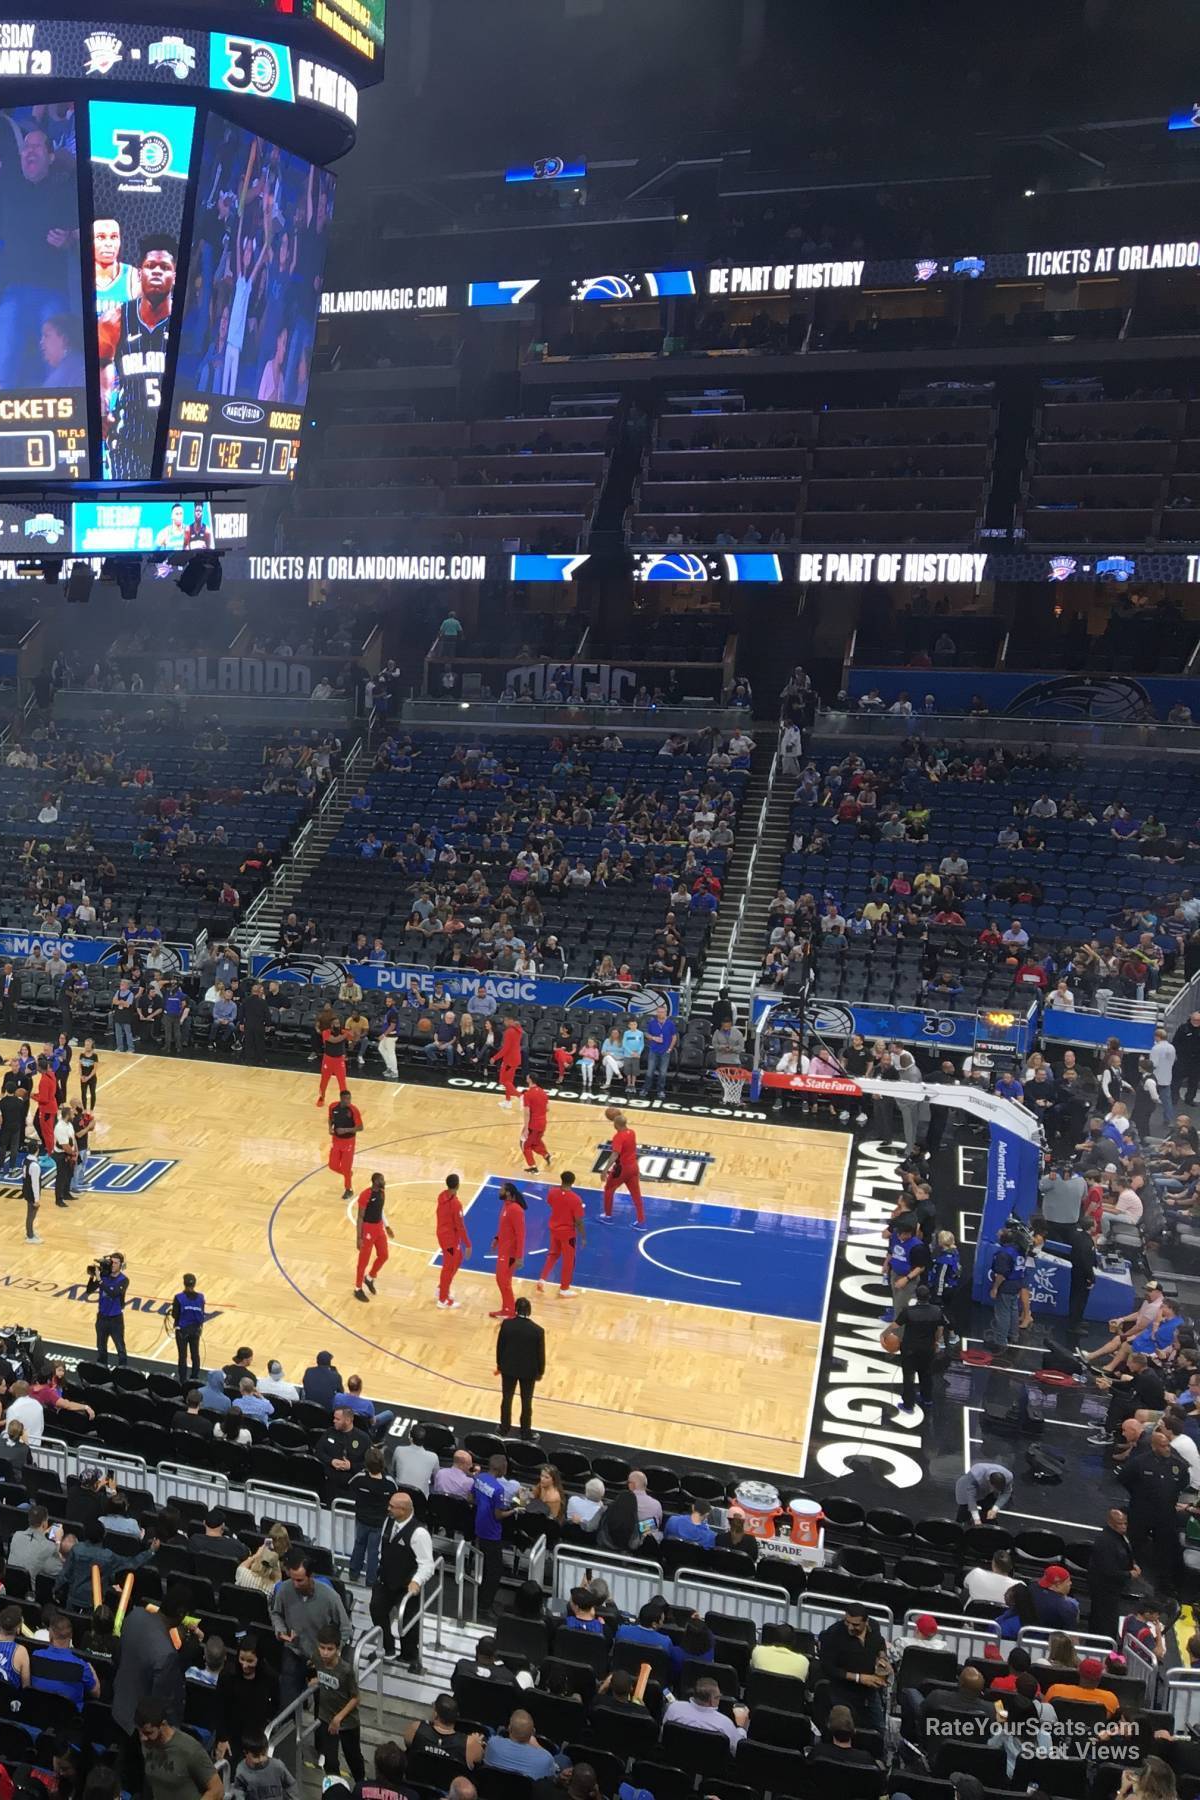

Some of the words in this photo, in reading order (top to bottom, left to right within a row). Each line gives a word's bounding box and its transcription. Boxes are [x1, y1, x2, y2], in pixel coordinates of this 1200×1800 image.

[1027, 249, 1090, 275] TICKETS
[1094, 248, 1115, 272] AT
[1118, 242, 1200, 270] ORLANDO
[710, 269, 730, 293] BE
[731, 266, 772, 292] PART
[774, 265, 794, 290] OF
[796, 261, 864, 288] HISTORY
[319, 286, 447, 313] RLANDOMAGIC.COM
[146, 378, 161, 407] 5
[181, 401, 209, 422] MAGIC
[269, 411, 301, 430] ROCKETS
[28, 438, 44, 465] 0
[219, 442, 242, 468] 4:02
[249, 557, 303, 579] TICKETS
[307, 557, 324, 579] AT
[328, 556, 485, 580] ORLANDOMAGIC.COM
[799, 554, 822, 581] BE
[825, 554, 874, 581] PART
[876, 554, 901, 582] OF
[904, 554, 987, 582] HISTORY
[12, 937, 74, 958] MAGIC
[377, 969, 434, 991] PURE
[461, 979, 537, 1000] MAGIC
[987, 1044, 1016, 1052] TISSOT
[448, 1077, 767, 1121] OrladoMagic.com
[997, 1139, 1008, 1201] AdventHealth
[816, 1312, 925, 1489] MAGIC
[799, 1521, 810, 1532] G
[757, 1541, 803, 1557] TORADE
